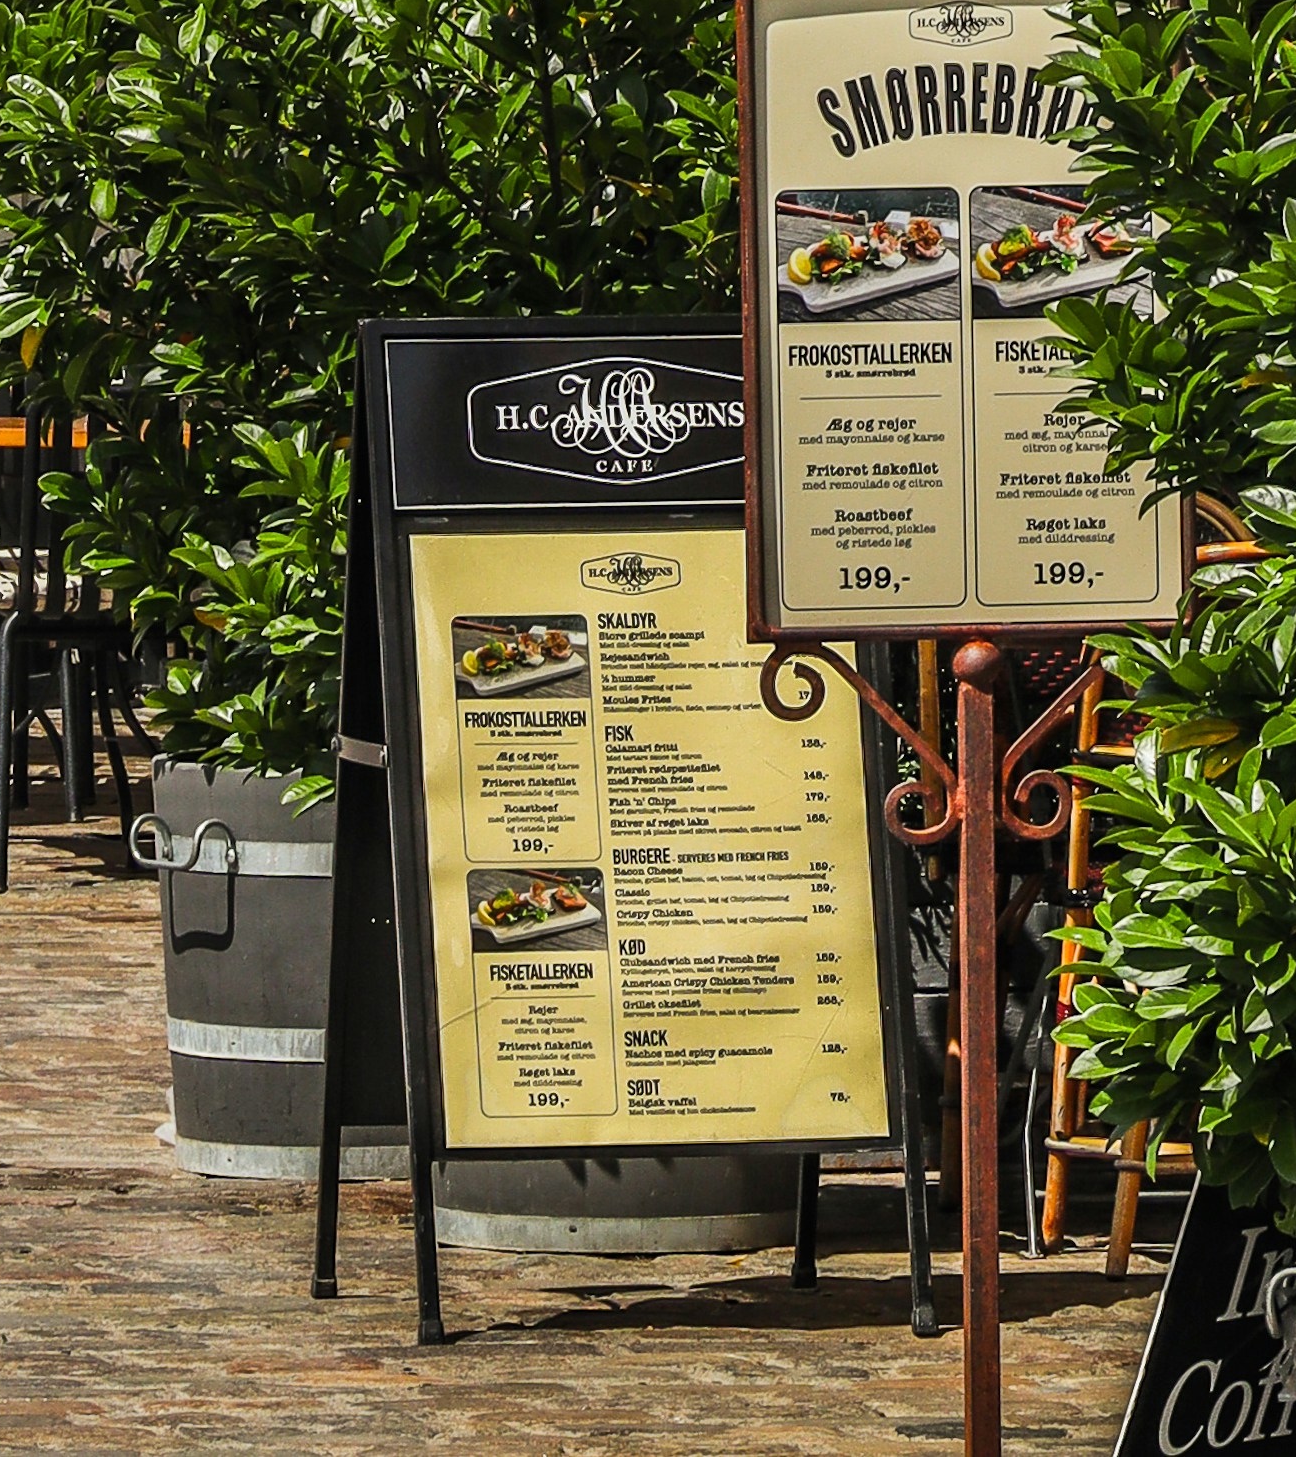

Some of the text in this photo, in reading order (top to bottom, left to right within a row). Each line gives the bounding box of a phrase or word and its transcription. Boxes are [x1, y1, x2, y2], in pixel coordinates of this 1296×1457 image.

[788, 342, 952, 366] FROKOSTTALLERKEN
[995, 340, 1075, 362] FISKETAL
[494, 404, 552, 431] H.C.
[825, 417, 916, 433] Æg og rejer
[1043, 412, 1087, 428] Rejer
[798, 430, 945, 445] med mayonnaise og karse
[1004, 430, 1028, 440] med
[1031, 430, 1050, 441] æg,
[1022, 439, 1111, 454] citron og karse
[595, 458, 654, 474] CAFE
[806, 462, 939, 477] Friteret fiskefilet
[801, 478, 942, 490] med remoulade og citron
[999, 473, 1061, 485] Friteret
[995, 487, 1135, 499] med remoulade og citron
[834, 508, 913, 522] Roastbeef
[810, 523, 936, 537] med peberrod, pickles
[1026, 517, 1106, 533] Røget laks
[835, 537, 912, 550] og ristede løg
[1018, 531, 1115, 544] med dilddressing
[839, 566, 910, 592] 199,-
[1034, 562, 1103, 587] 199,-
[597, 612, 657, 629] SKALDYR
[464, 710, 586, 727] FROKOSTTALLERKEN
[604, 725, 633, 741] FISK
[512, 838, 553, 853] 199,-
[612, 847, 670, 864] BURGERE
[677, 850, 788, 863] SERVERES MED FRENCH FRIES
[618, 939, 645, 955] KØD
[489, 963, 593, 981] FISKETALLERKEN
[624, 1029, 668, 1047] SNACK
[627, 1079, 660, 1096] SØDT
[528, 1092, 569, 1107] 199,-
